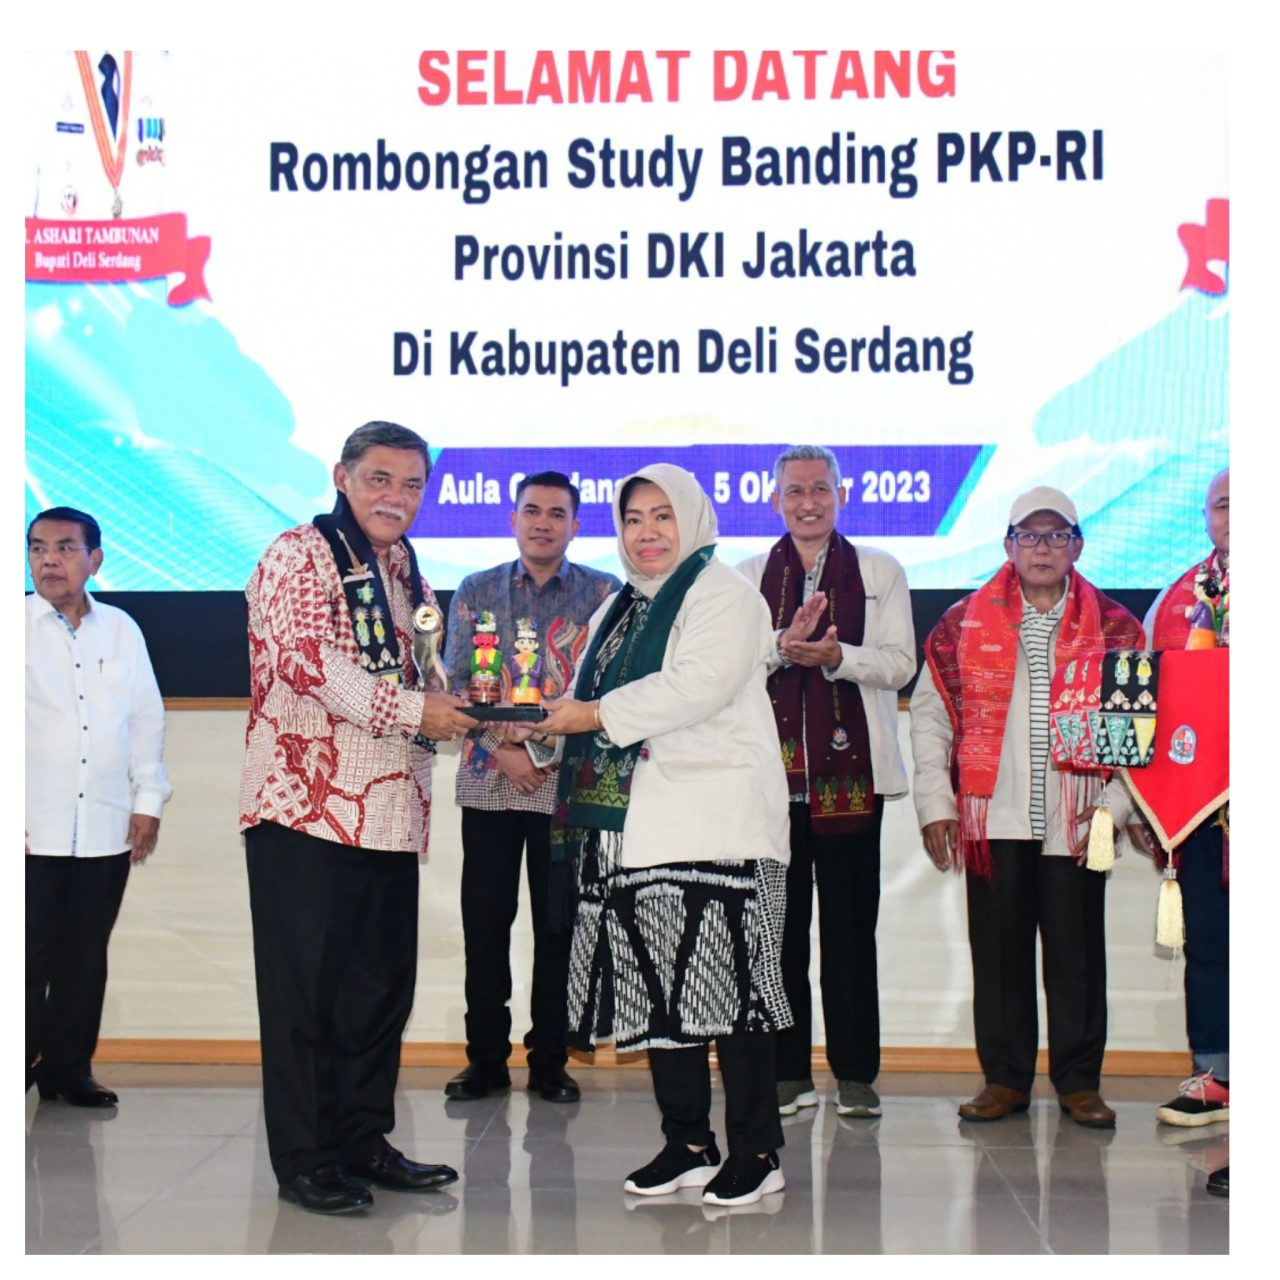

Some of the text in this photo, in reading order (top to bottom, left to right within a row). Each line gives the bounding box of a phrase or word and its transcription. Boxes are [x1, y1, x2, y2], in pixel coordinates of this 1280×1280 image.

[418, 50, 955, 105] SELAMAT DATANG
[270, 130, 1103, 204] Rombongan Study Banding PKP-RI
[34, 228, 82, 244] ASHARI
[86, 227, 159, 244] TAMBUNAN
[455, 229, 916, 280] Provinsi DKI Jakarta
[35, 252, 141, 272] Bupati Deli Serdang
[394, 325, 973, 387] Di Kabupaten Deli Serdang
[439, 473, 501, 504] Aula
[714, 471, 730, 503] 5
[862, 471, 930, 502] 2023
